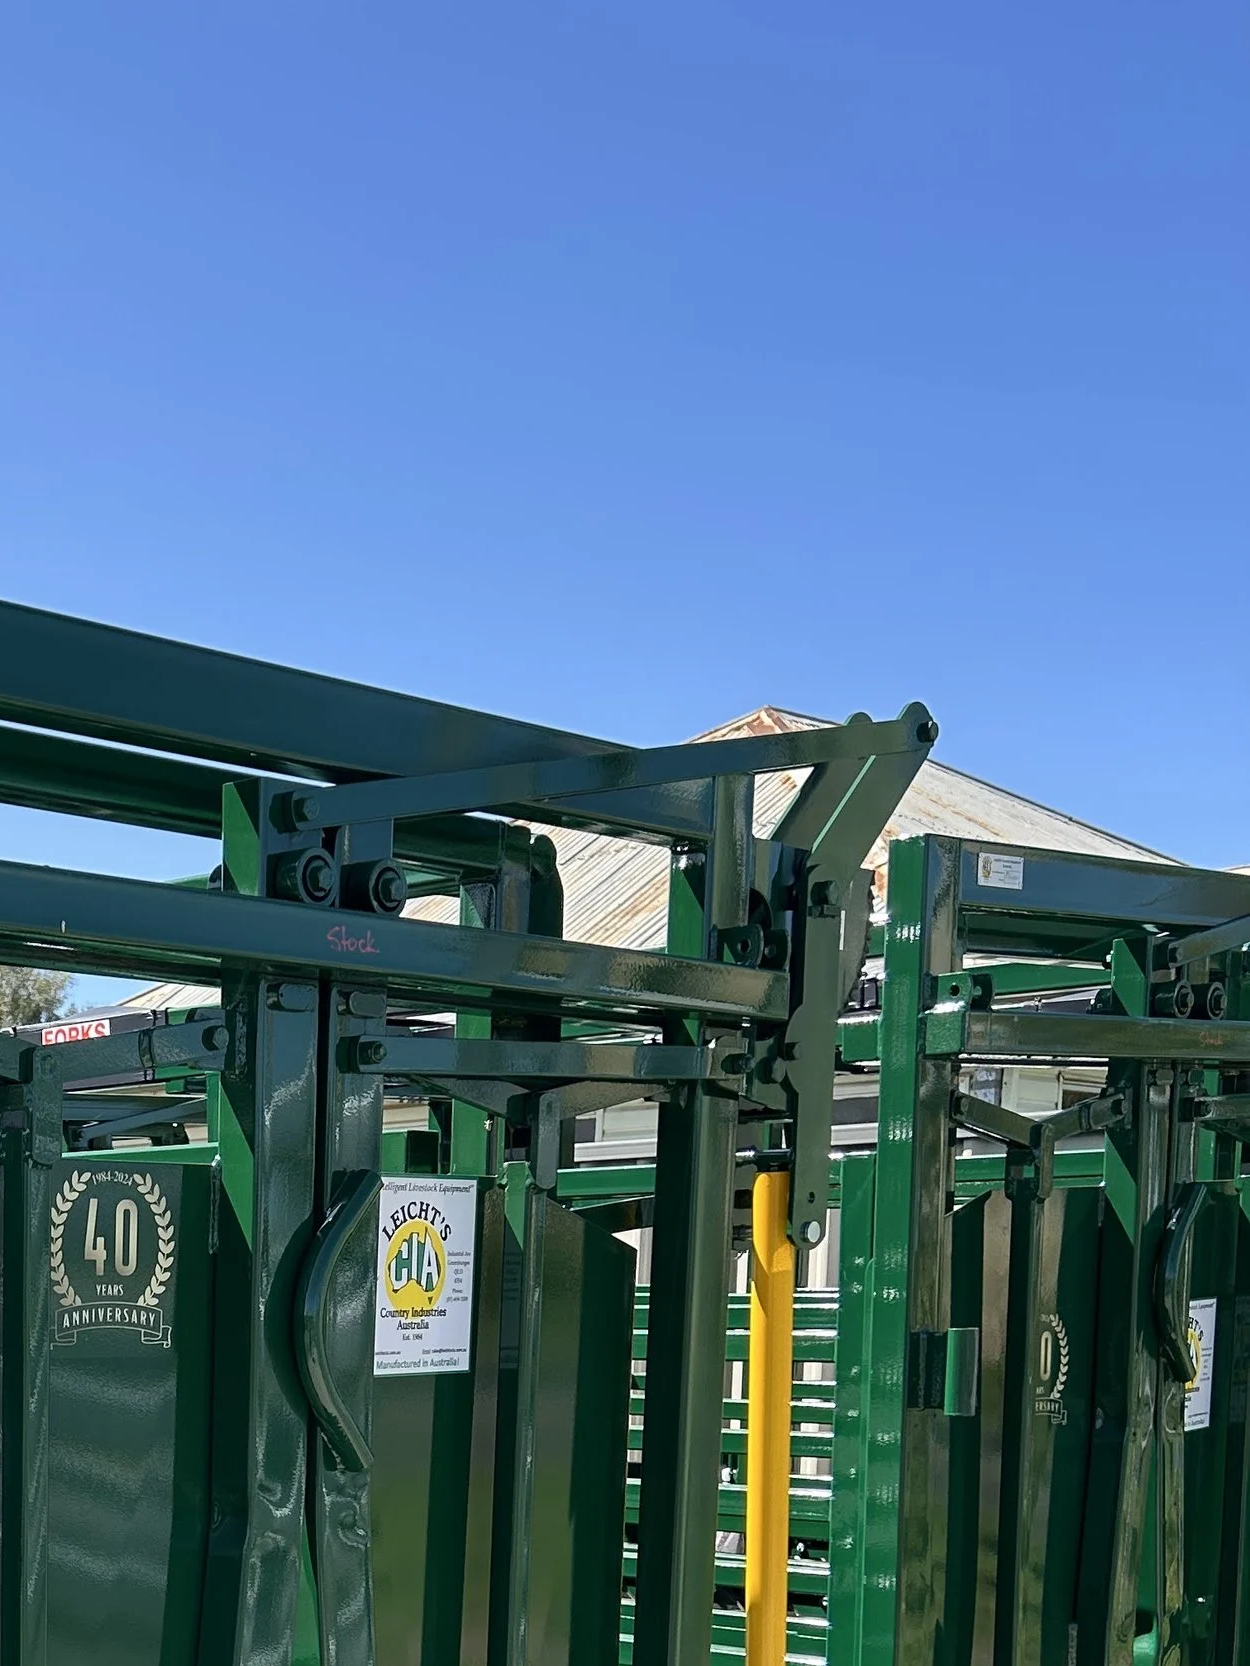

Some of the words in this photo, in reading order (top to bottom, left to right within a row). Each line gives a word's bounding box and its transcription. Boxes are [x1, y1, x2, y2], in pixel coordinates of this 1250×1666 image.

[44, 1022, 106, 1045] FORKS
[91, 1170, 134, 1186] 1984-2024
[408, 1183, 438, 1192] Livestock
[381, 1201, 452, 1242] LEICHT'S
[84, 1198, 138, 1276] 40
[391, 1229, 440, 1291] CIA
[96, 1284, 124, 1296] YEARS
[62, 1307, 156, 1329] ANNIVERSARY
[380, 1307, 410, 1319] Country
[411, 1307, 447, 1317] Industries
[396, 1320, 430, 1330] Australia
[376, 1359, 421, 1369] Manufactured
[422, 1359, 428, 1367] in
[430, 1357, 459, 1367] Australia!
[1040, 1331, 1052, 1380] 0
[1035, 1401, 1059, 1413] ERSARY
